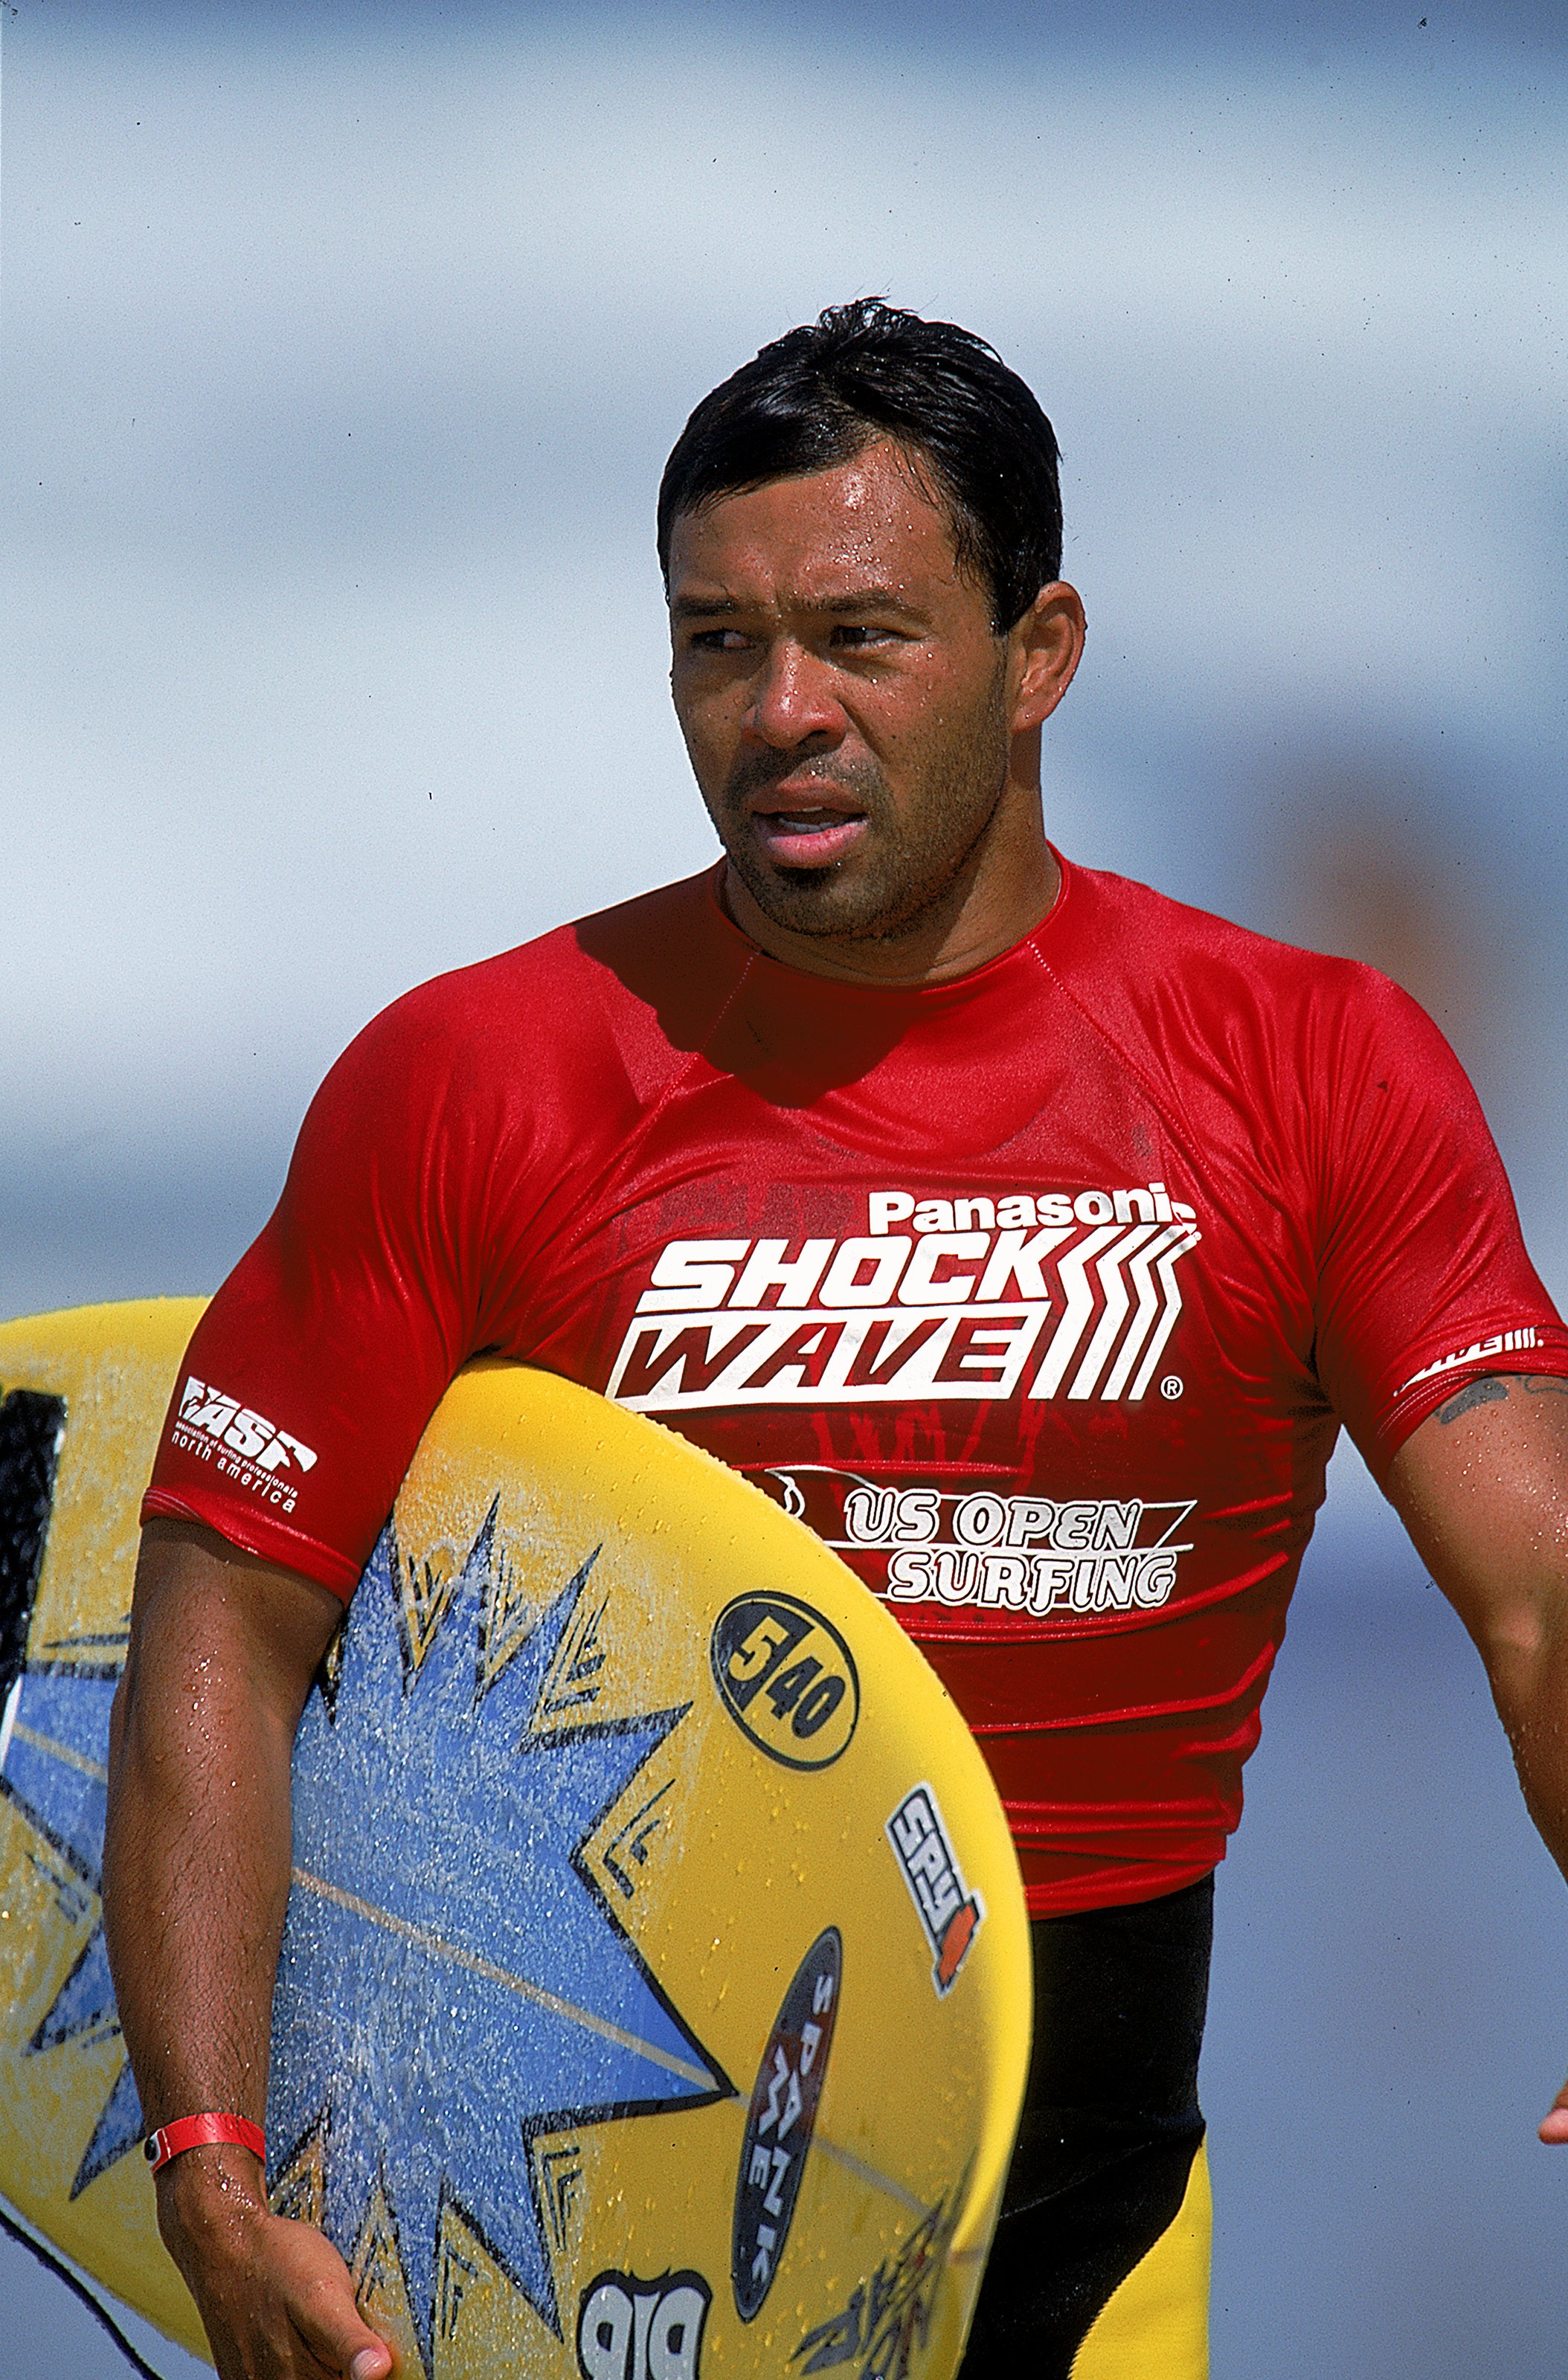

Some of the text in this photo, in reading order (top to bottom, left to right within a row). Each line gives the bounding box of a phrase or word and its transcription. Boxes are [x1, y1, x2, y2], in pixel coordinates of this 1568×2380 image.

[635, 1226, 1078, 1313] SHOCK
[614, 1315, 1030, 1400] WAVE
[171, 1430, 297, 1514] north america
[846, 1488, 1145, 1551] US OPEN
[888, 1549, 1178, 1615] SURFING
[893, 1794, 964, 1934] SPY
[751, 1973, 834, 2282] SPANK
